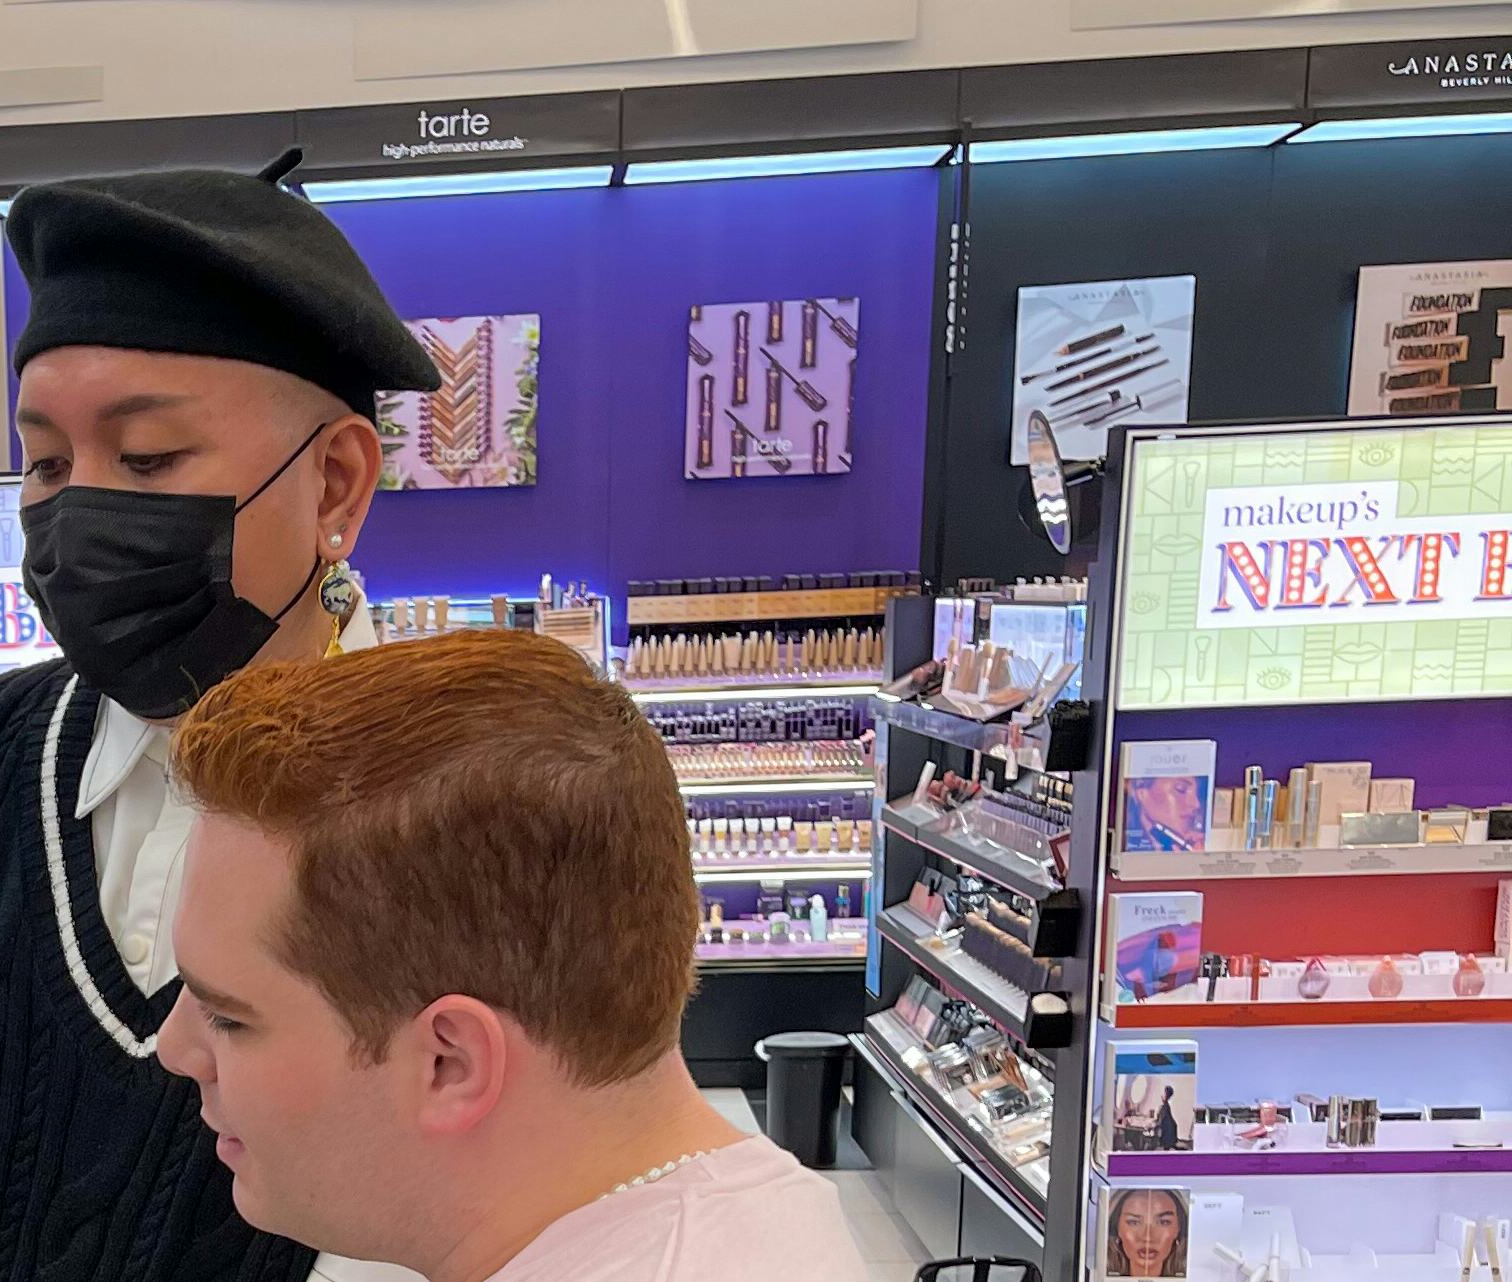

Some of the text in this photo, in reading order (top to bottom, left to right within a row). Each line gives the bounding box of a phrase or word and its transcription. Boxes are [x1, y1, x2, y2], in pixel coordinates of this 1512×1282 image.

[1440, 77, 1489, 88] BEVERLY
[418, 108, 490, 138] tarte
[1223, 491, 1379, 530] makeup's
[1211, 532, 1461, 612] NEXT
